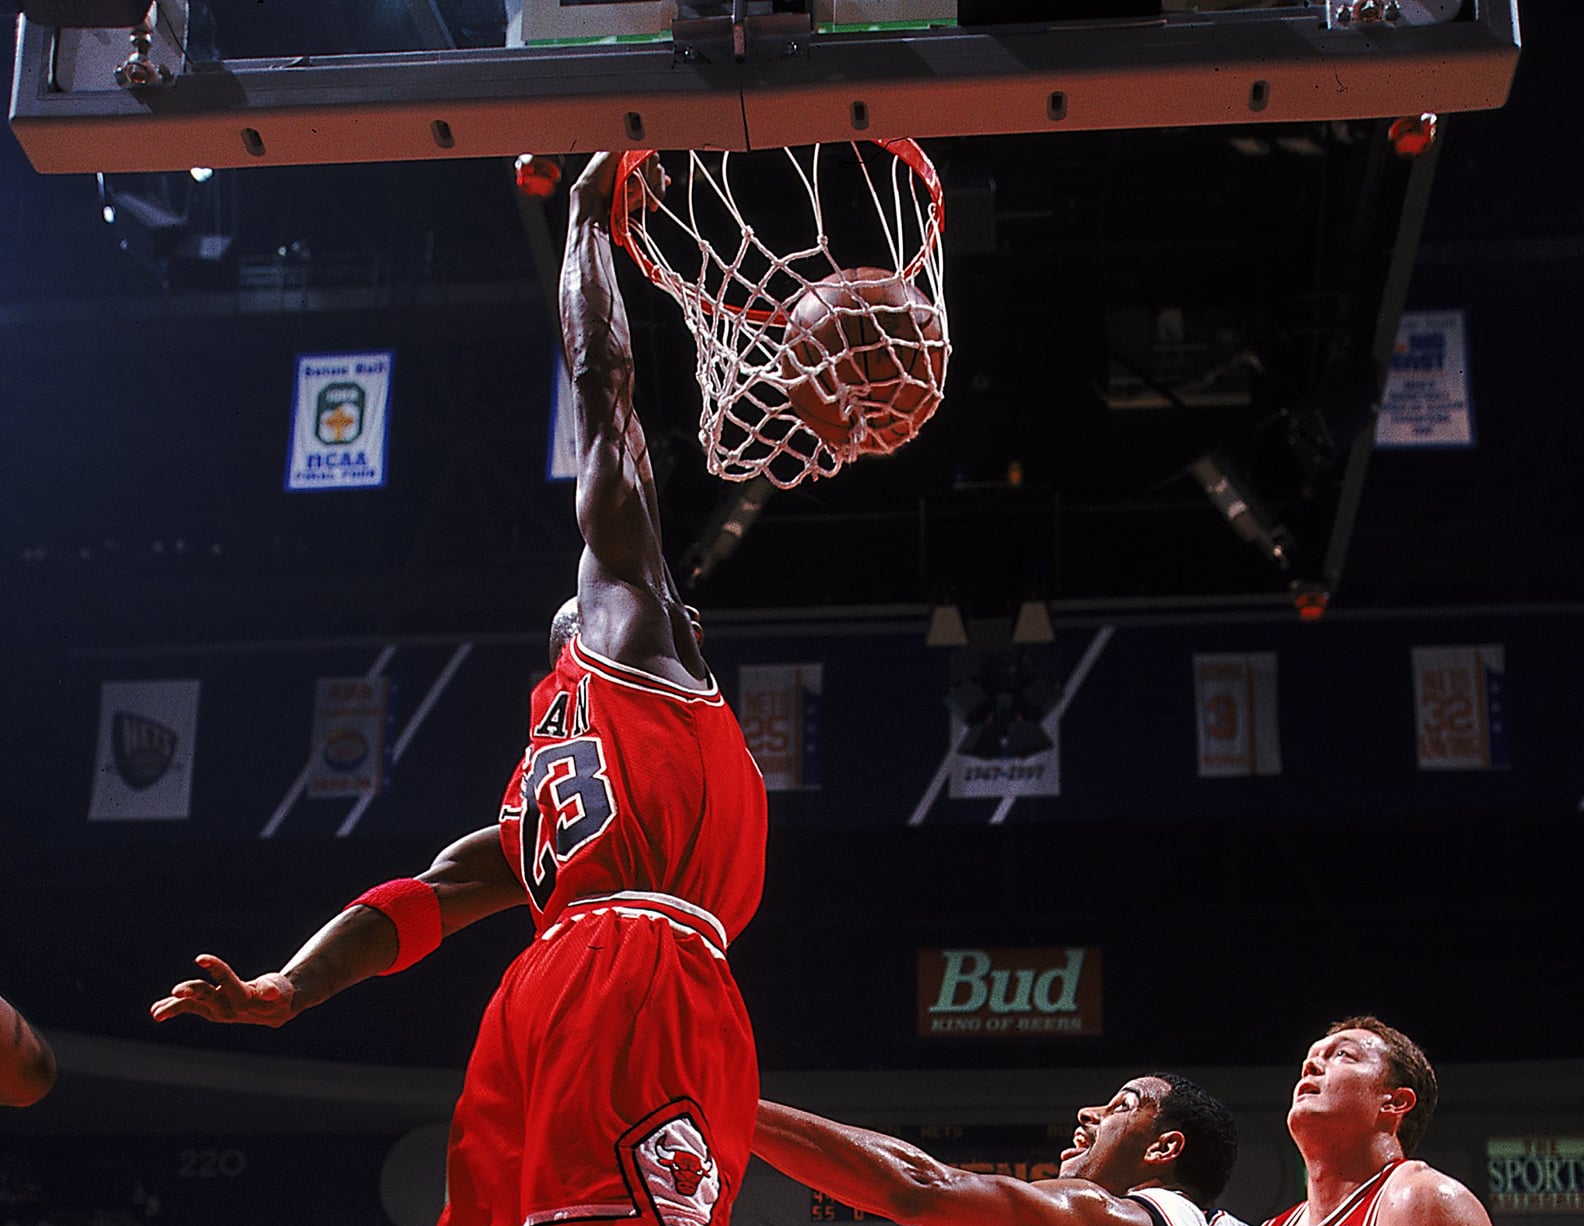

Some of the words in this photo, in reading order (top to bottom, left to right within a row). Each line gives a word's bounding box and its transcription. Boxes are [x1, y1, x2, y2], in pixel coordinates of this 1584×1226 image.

[1208, 695, 1236, 739] 3
[928, 947, 1087, 1014] Bud
[931, 1016, 981, 1031] KING
[986, 1016, 1013, 1031] OF
[1018, 1016, 1082, 1031] BEERS
[1488, 1156, 1584, 1192] SPORT
